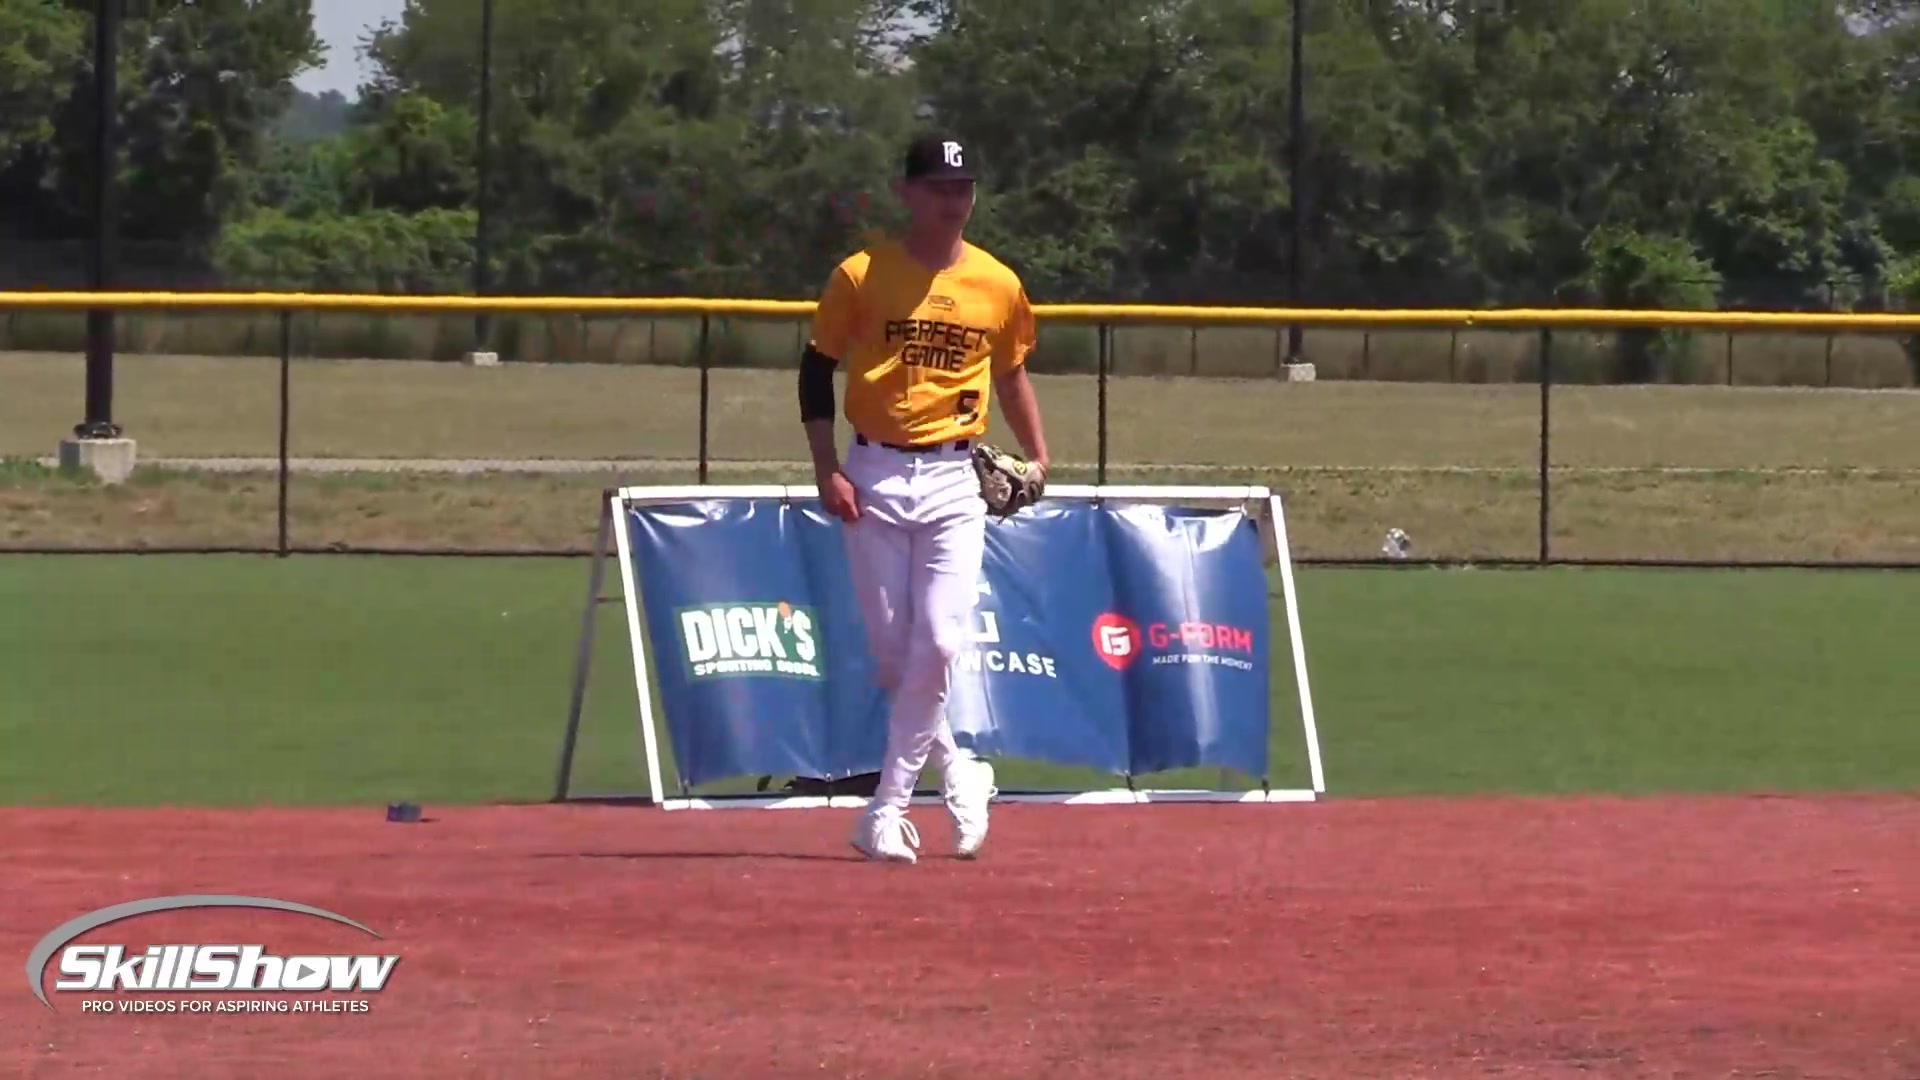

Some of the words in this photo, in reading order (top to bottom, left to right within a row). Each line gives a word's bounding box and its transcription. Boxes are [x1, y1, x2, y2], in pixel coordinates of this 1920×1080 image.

[942, 141, 963, 167] PG
[886, 319, 987, 351] PERFECT
[902, 344, 965, 372] GAME
[955, 389, 979, 426] 5
[681, 606, 816, 662] DICK'S
[1149, 622, 1252, 656] G-FORM
[957, 649, 1057, 678] WCASE
[1152, 654, 1180, 665] MADE
